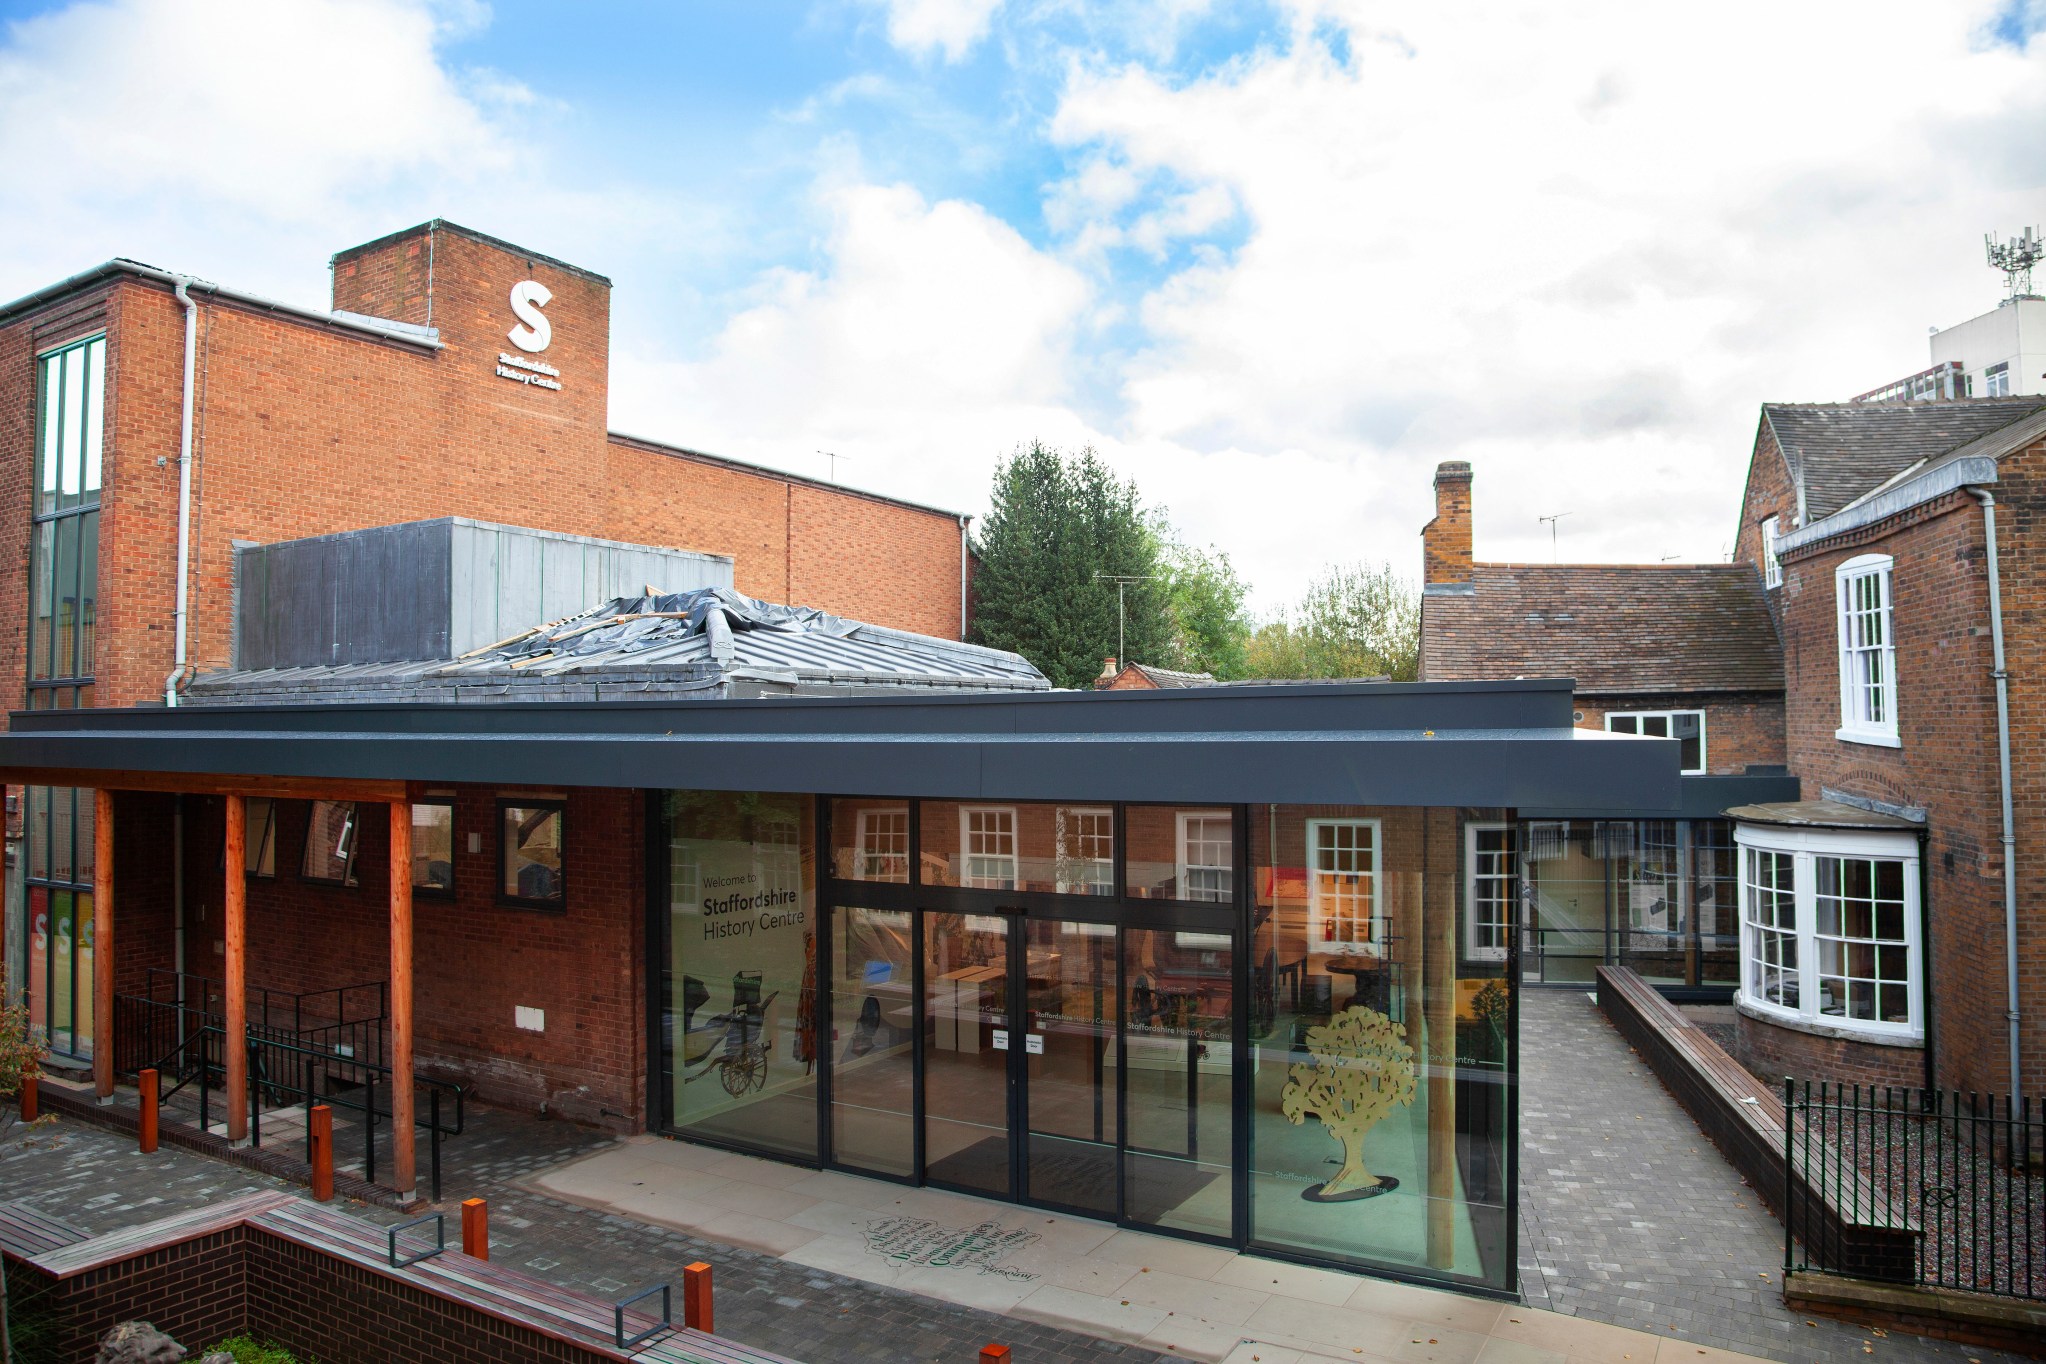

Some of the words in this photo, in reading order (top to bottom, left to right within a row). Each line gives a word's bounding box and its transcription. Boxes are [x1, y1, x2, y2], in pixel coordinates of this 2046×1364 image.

[507, 280, 553, 353] S
[498, 352, 560, 377] Staffordshire
[496, 365, 531, 385] History
[530, 374, 562, 391] Centre
[703, 874, 745, 889] Welcome
[747, 873, 757, 884] to
[703, 888, 797, 917] Staffordshire
[704, 920, 755, 941] History
[759, 911, 805, 930] Centre
[1034, 1011, 1073, 1021] Staffordshire
[1073, 1015, 1095, 1025] History
[1095, 1017, 1116, 1026] Centre
[1127, 1021, 1175, 1034] Staffordshire
[1176, 1027, 1203, 1039] History
[1204, 1030, 1231, 1040] Centre
[1413, 1053, 1444, 1063] Hitory
[1275, 1170, 1327, 1185] Staffordshire
[890, 1231, 946, 1260] Discover
[929, 1223, 993, 1266] Communities
